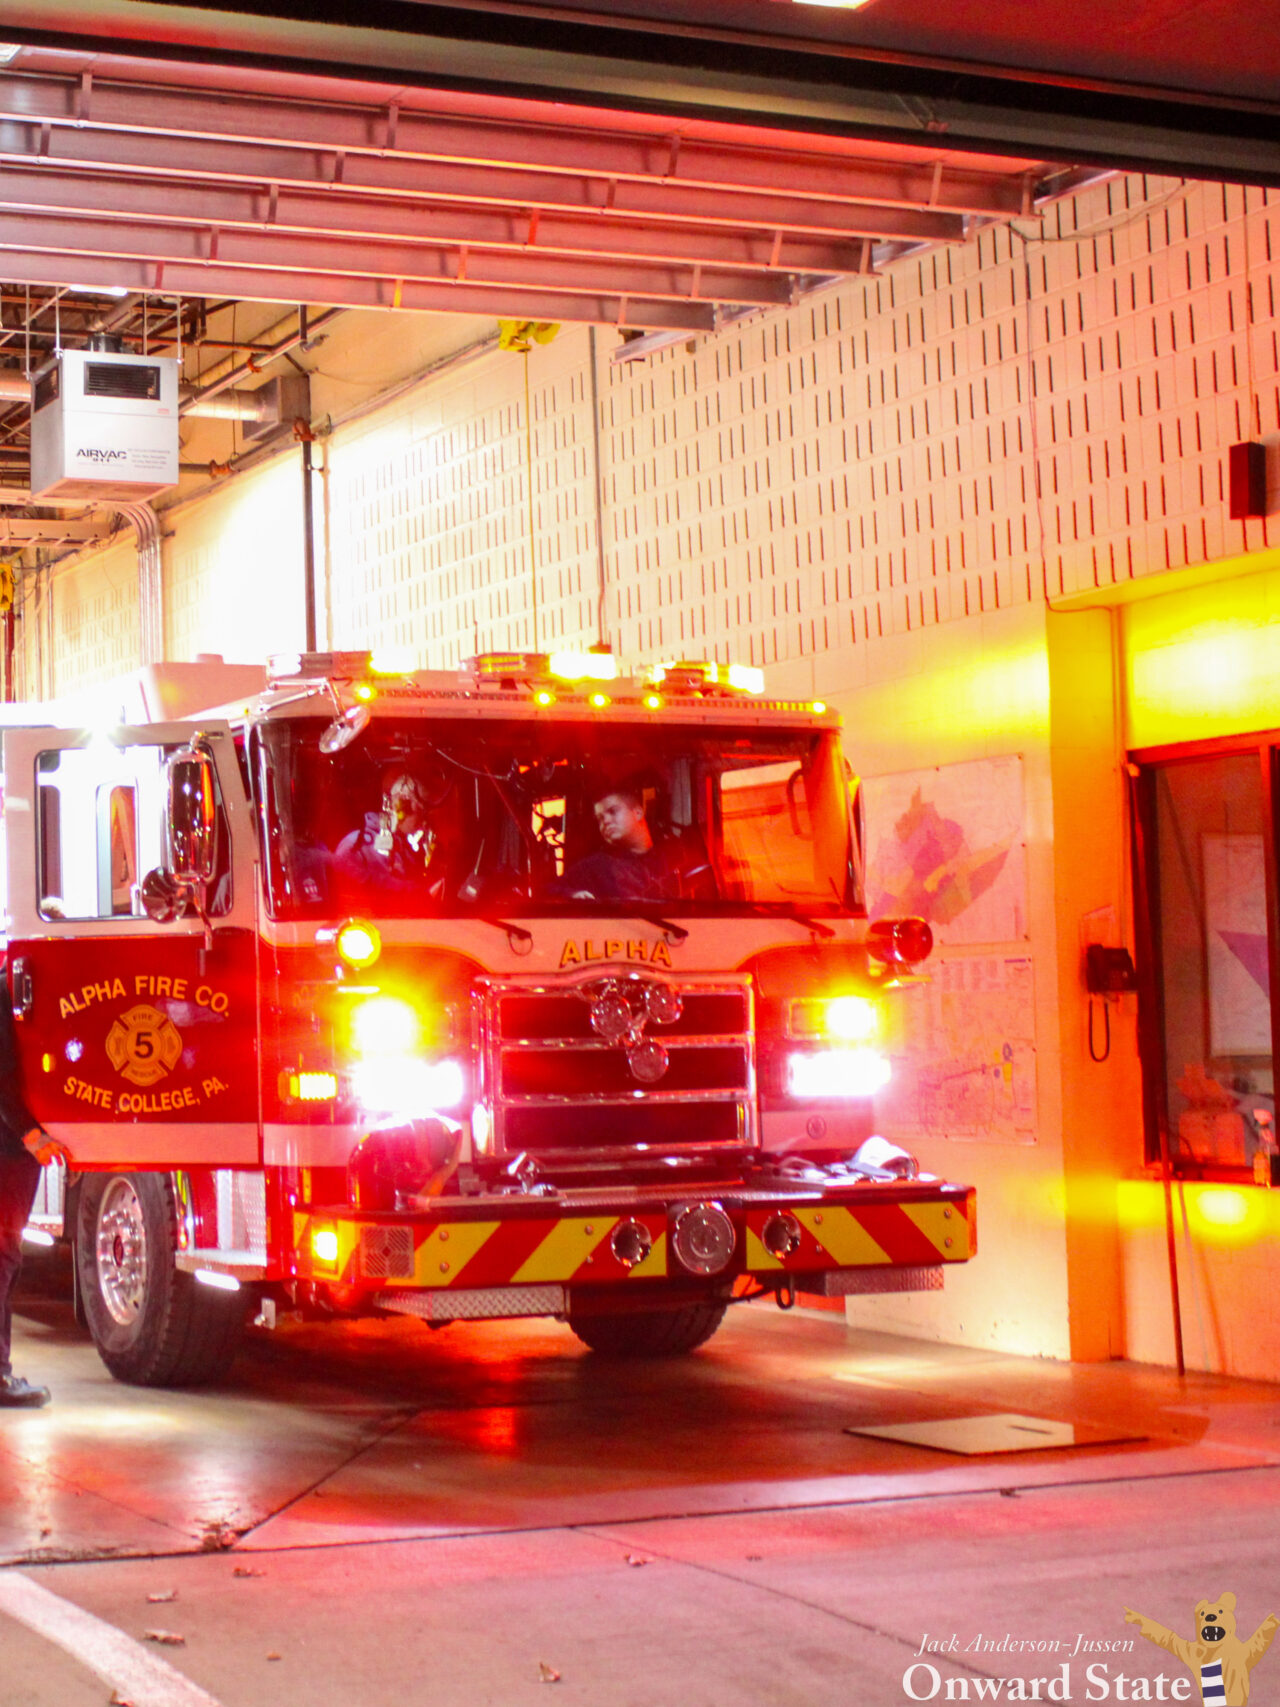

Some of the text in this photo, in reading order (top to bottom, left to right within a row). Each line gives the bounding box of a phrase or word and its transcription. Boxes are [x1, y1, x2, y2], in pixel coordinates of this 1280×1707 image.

[76, 448, 128, 460] AIRVAC
[559, 940, 672, 968] ALPHA
[59, 975, 229, 1019] ALPHA FIRE CO.
[134, 1031, 154, 1059] 5
[64, 1076, 229, 1113] STATE COLLEGE, PA.
